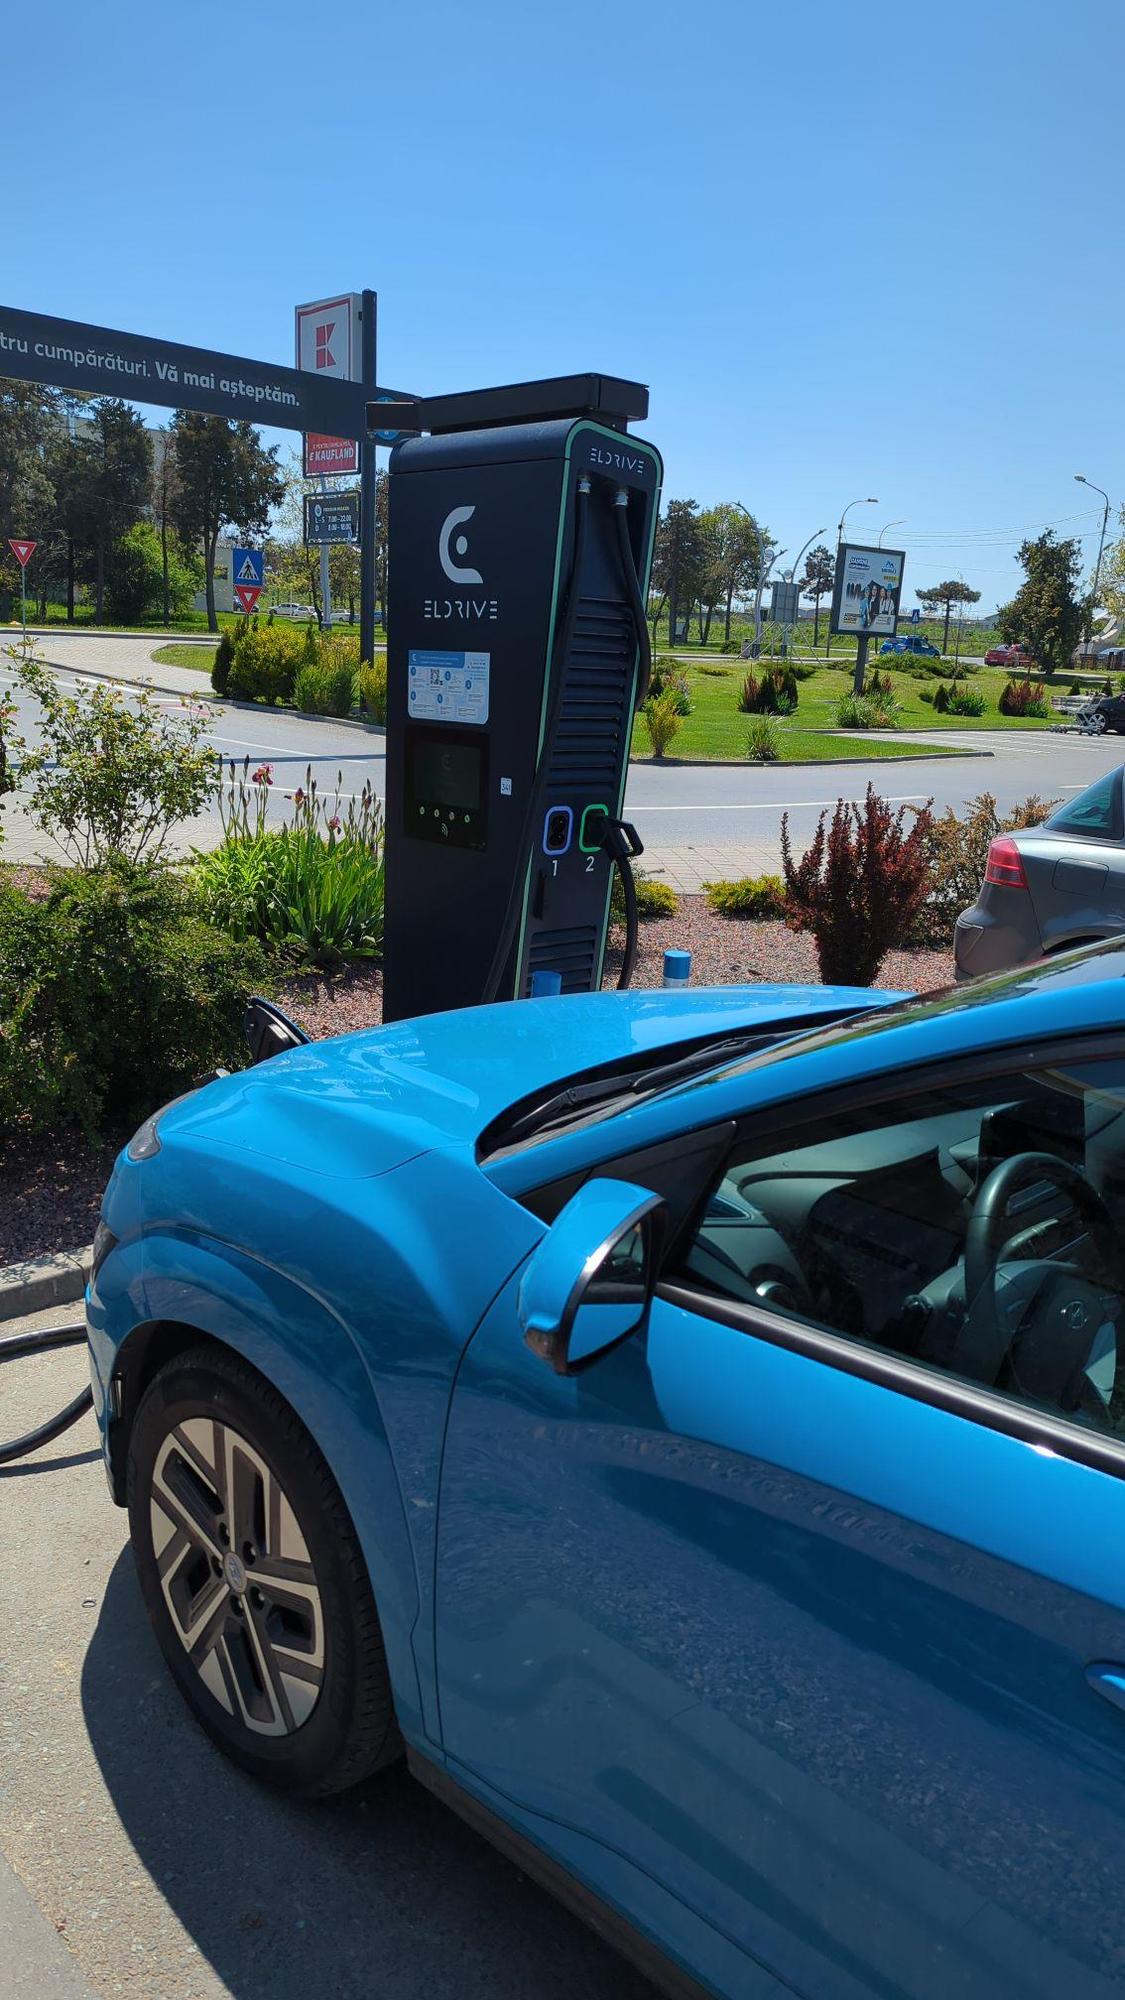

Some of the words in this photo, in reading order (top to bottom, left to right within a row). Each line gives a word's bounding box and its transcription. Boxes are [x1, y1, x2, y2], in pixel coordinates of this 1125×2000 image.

[34, 343, 151, 378] cumpărături.
[155, 361, 179, 383] Vă
[183, 372, 215, 390] mai
[219, 379, 300, 407] așteptăm.
[315, 447, 354, 462] KAUFLAND
[590, 448, 645, 474] ELDRIVE
[424, 600, 498, 620] ELDRIVE
[552, 859, 559, 877] 1
[585, 856, 595, 872] 2
